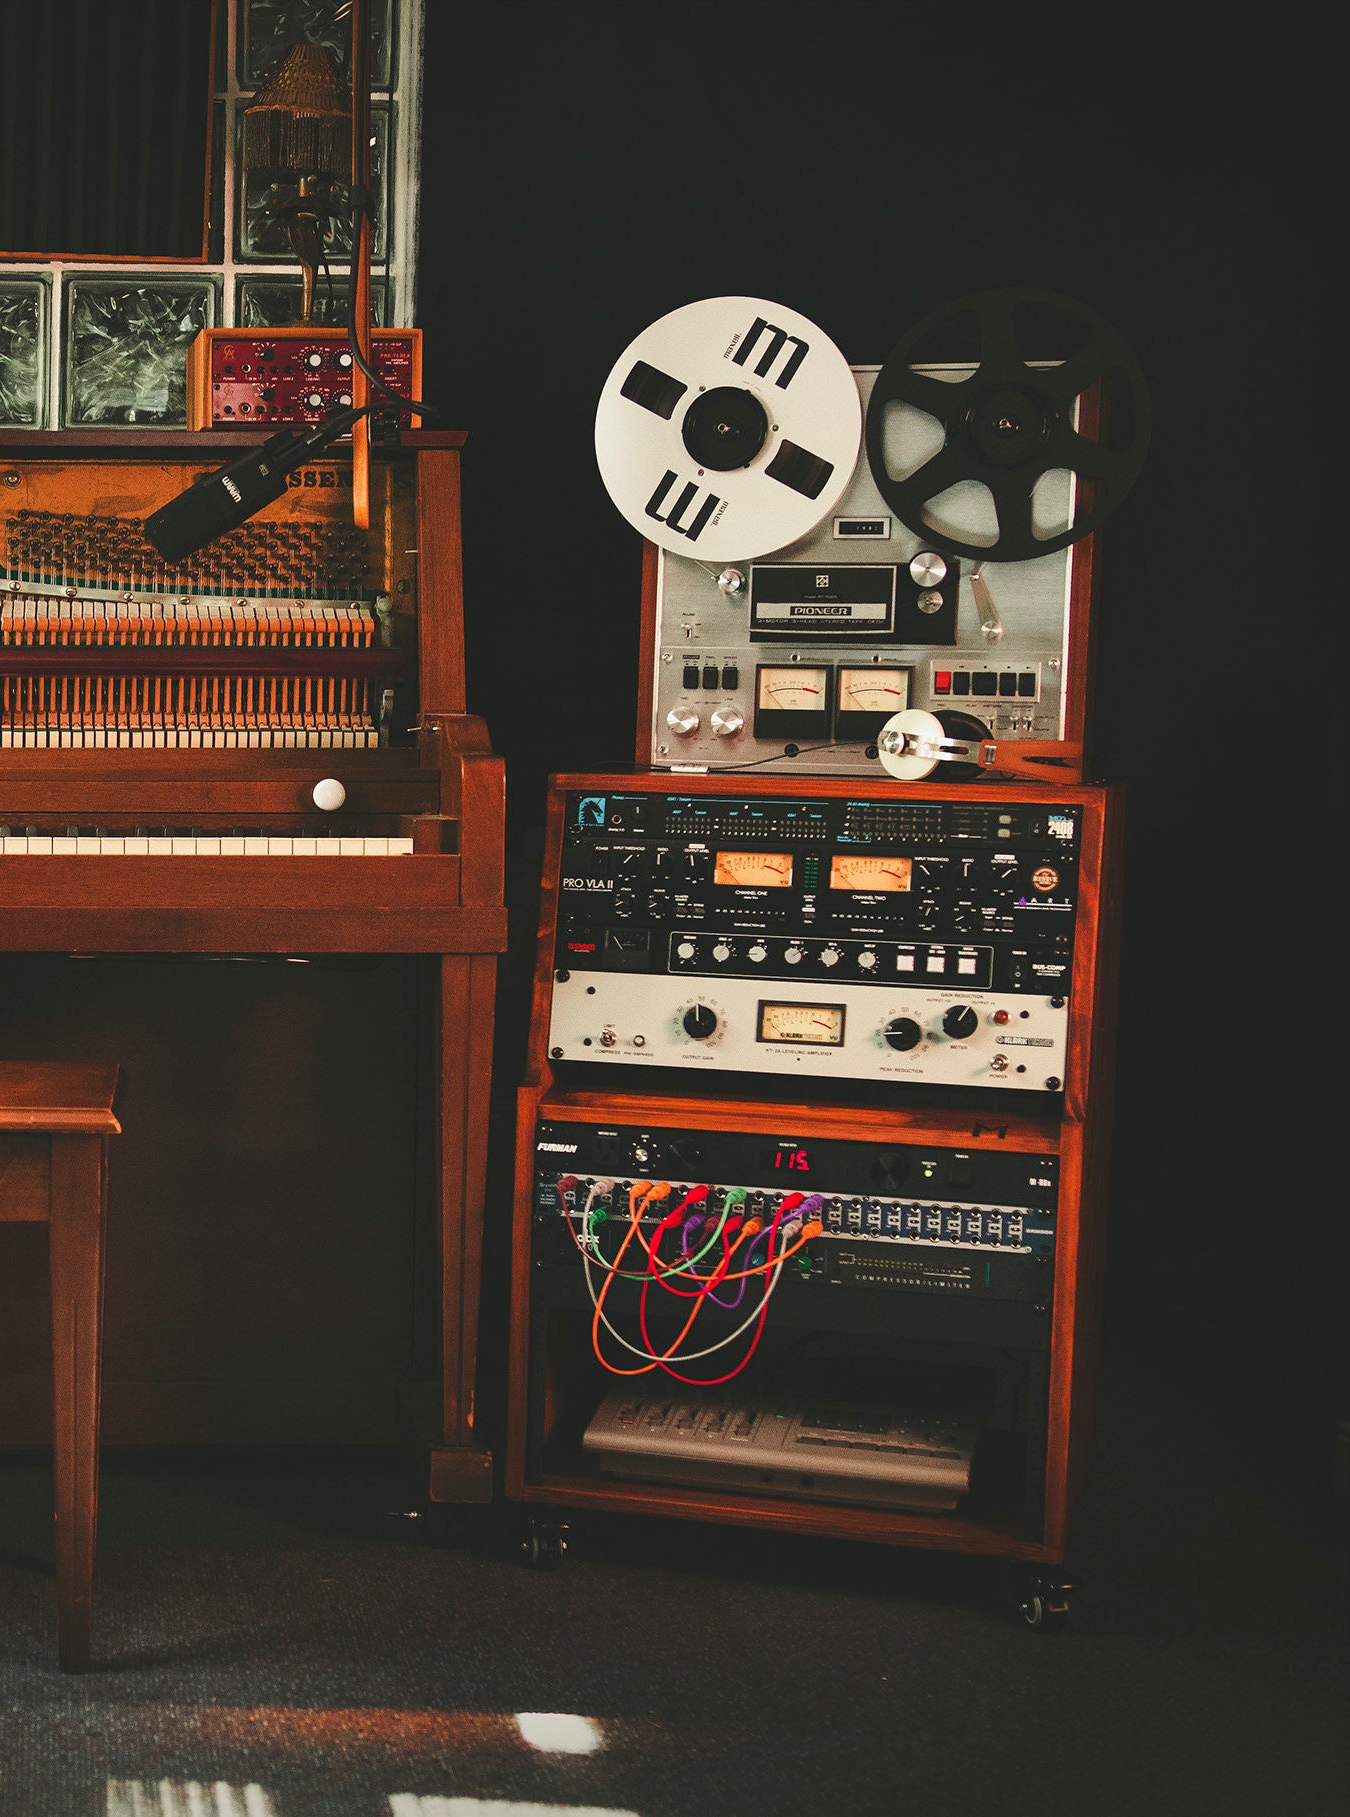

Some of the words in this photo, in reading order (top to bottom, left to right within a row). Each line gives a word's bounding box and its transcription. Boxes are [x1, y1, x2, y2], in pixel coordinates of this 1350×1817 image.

[793, 607, 849, 615] PIONEER
[562, 878, 584, 888] PRO
[585, 878, 606, 889] VLA
[607, 879, 614, 889] II
[536, 1142, 579, 1154] FURMAN
[774, 1149, 810, 1171] 115
